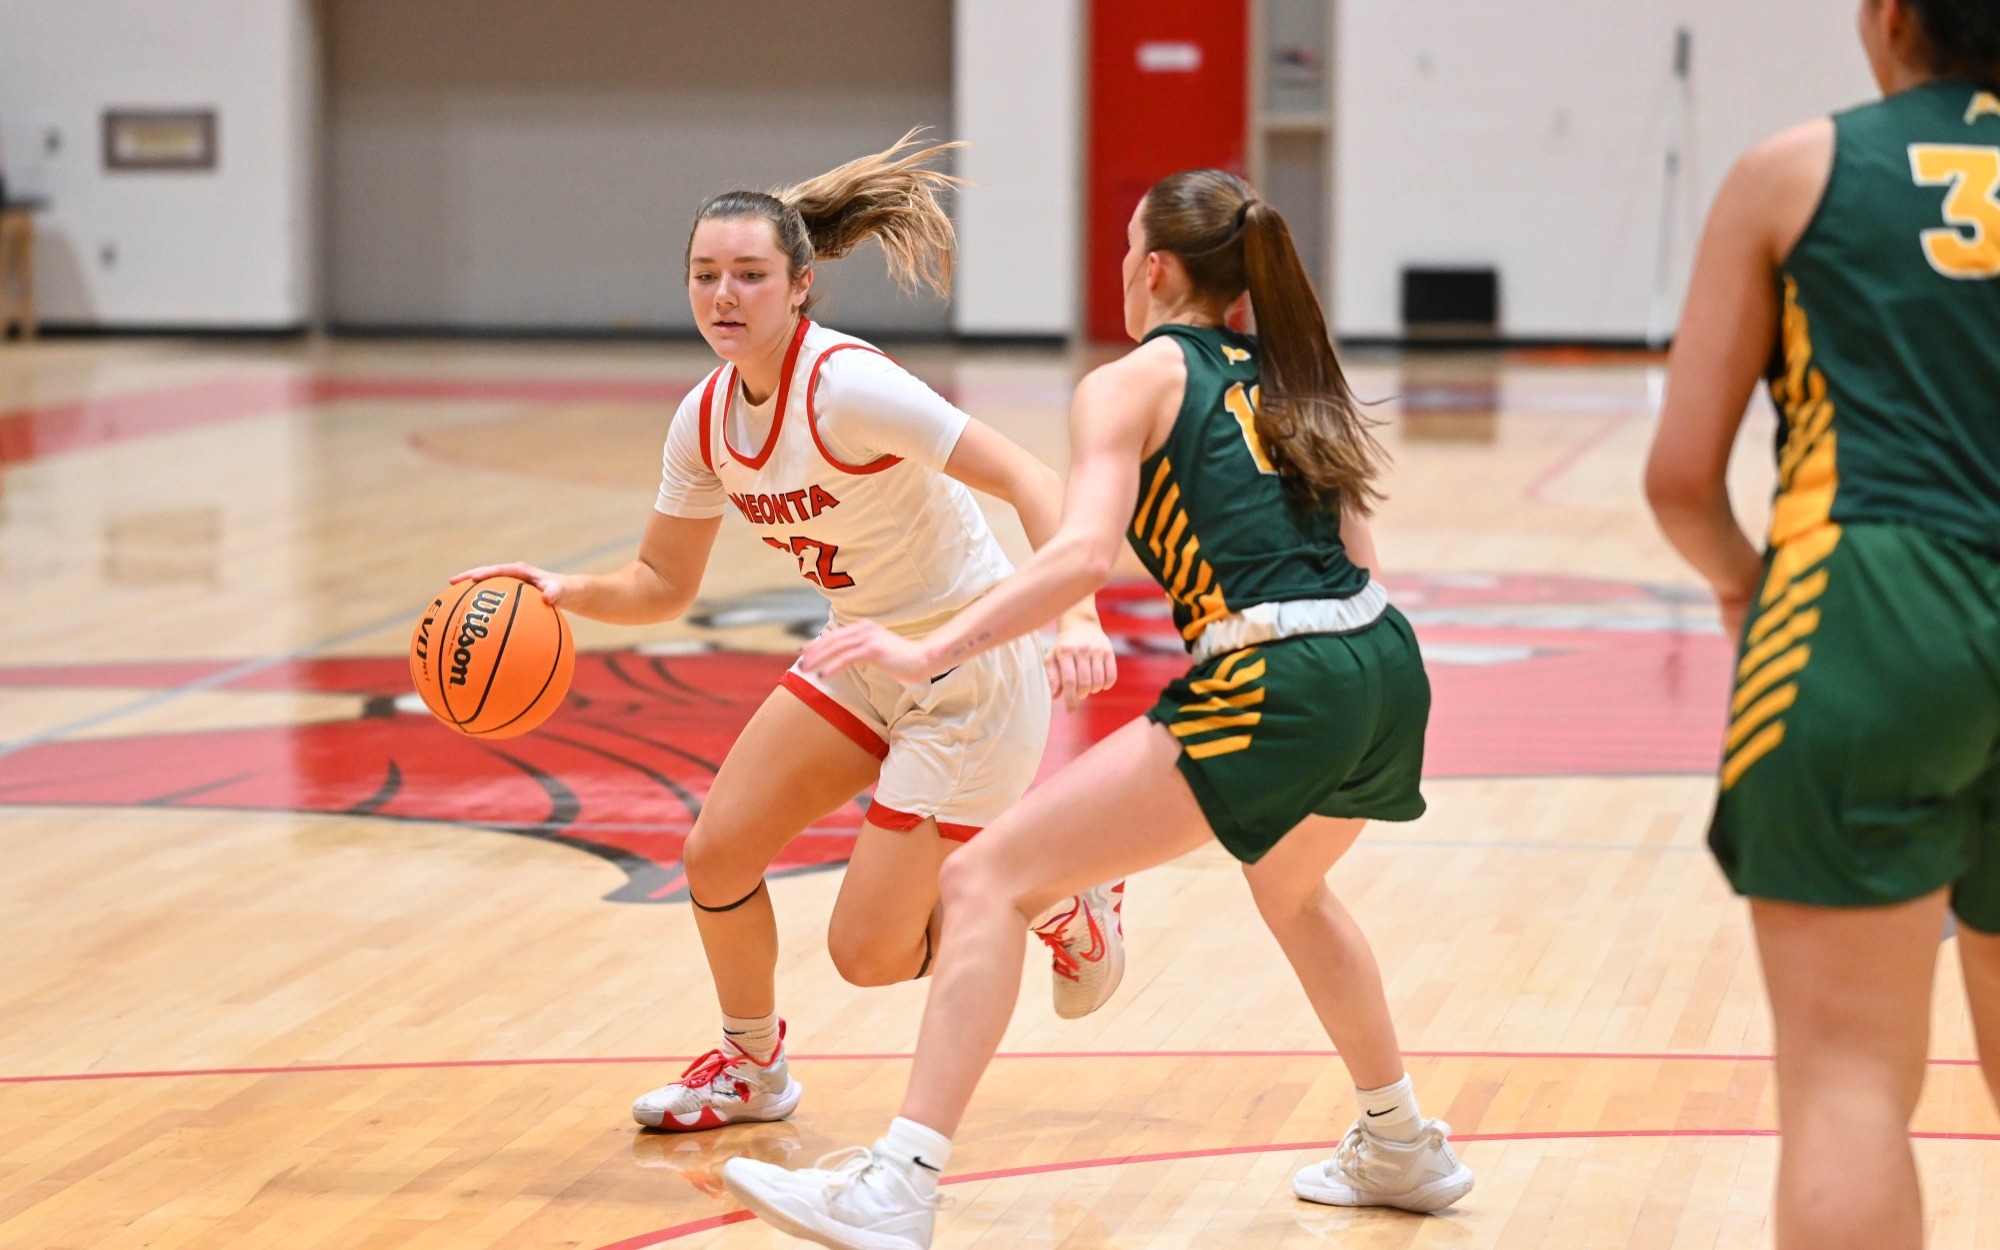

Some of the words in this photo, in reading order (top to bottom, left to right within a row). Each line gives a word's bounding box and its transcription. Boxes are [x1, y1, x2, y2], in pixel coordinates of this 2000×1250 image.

[1223, 381, 1280, 475] 1
[727, 484, 841, 525] NEONTA
[761, 536, 856, 590] 2
[416, 598, 443, 661] EVO
[449, 588, 508, 687] Wilson
